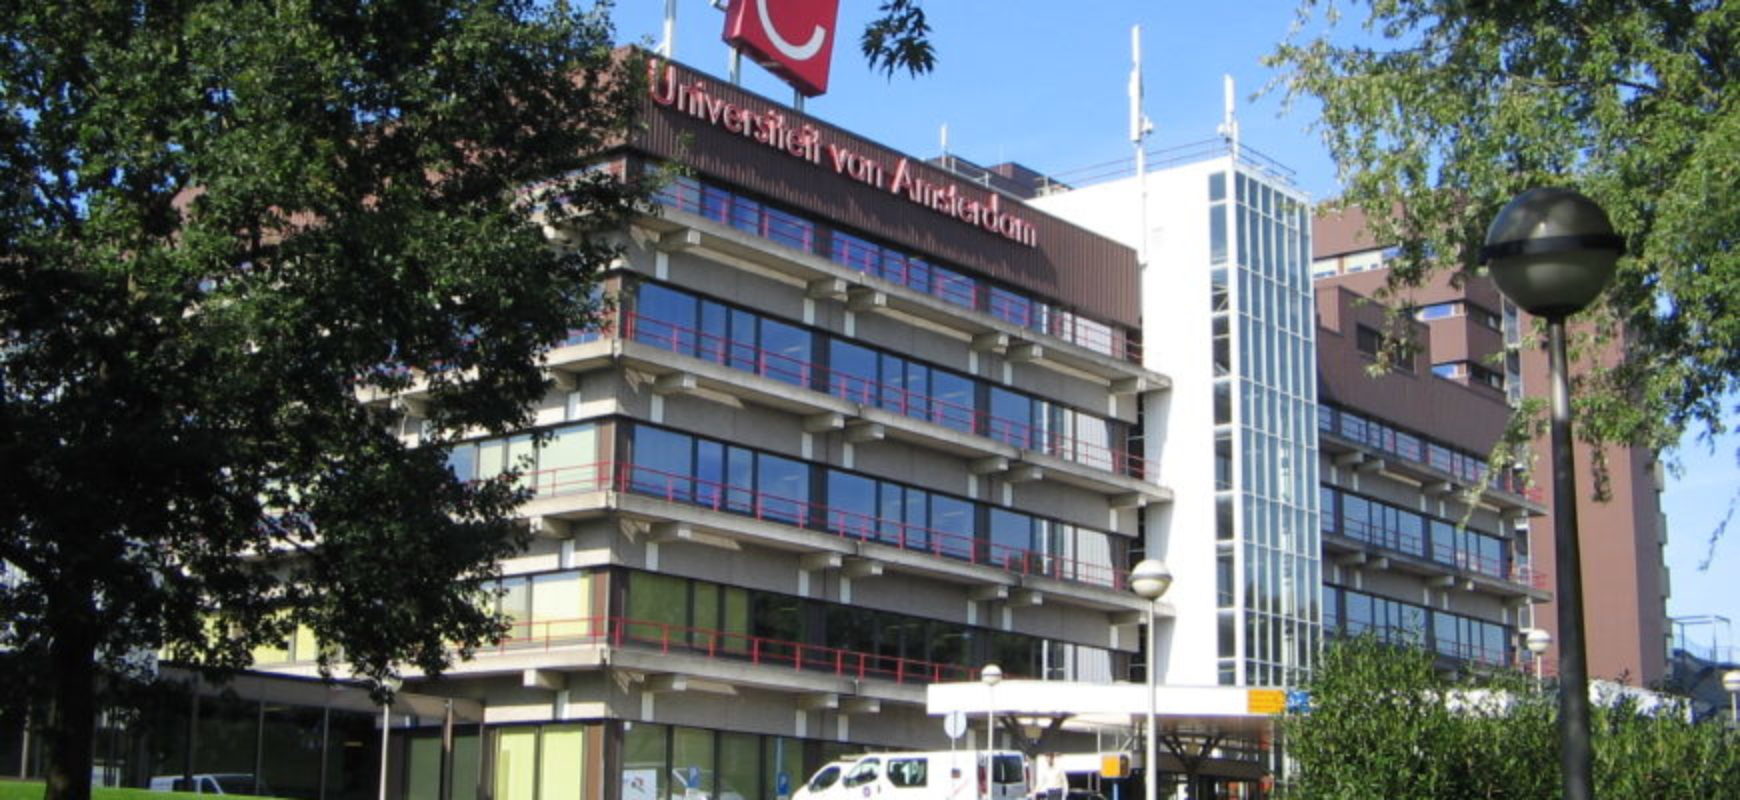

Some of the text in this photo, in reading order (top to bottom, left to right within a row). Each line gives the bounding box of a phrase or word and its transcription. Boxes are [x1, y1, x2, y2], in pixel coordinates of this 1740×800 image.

[648, 58, 1038, 248] Universiteit van Amsterdam
